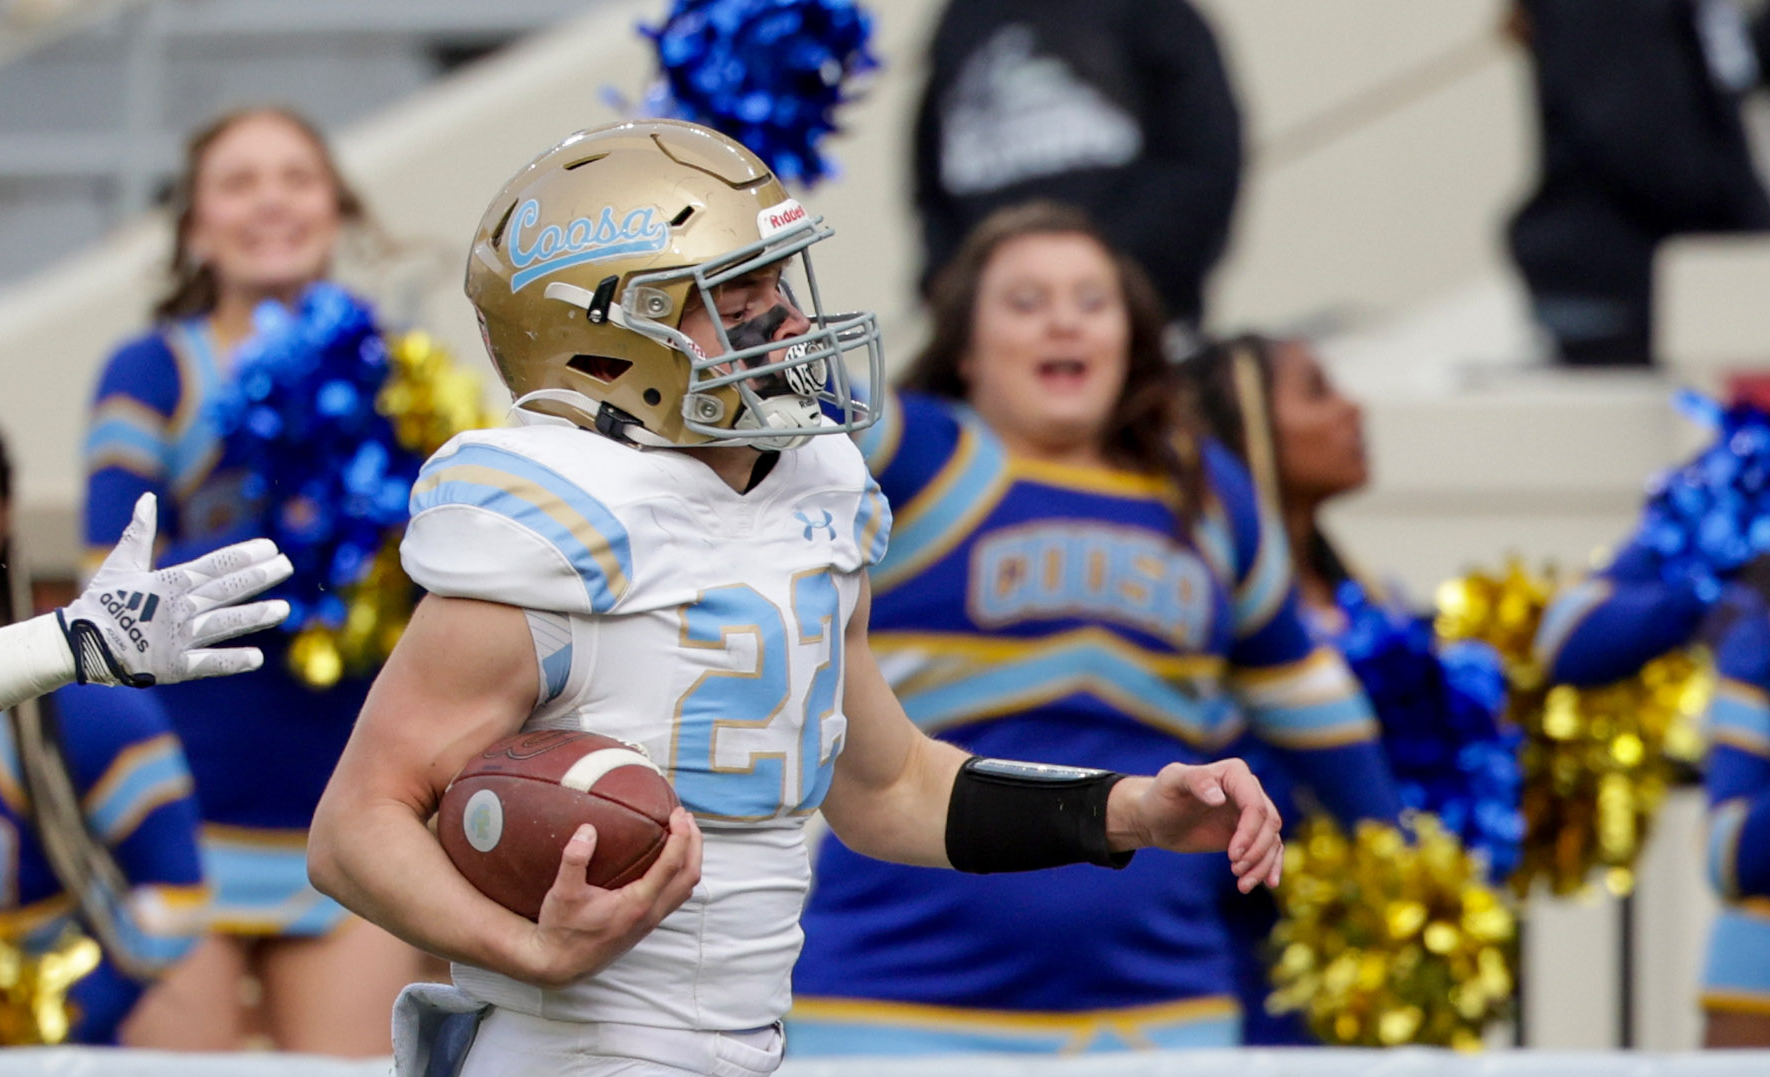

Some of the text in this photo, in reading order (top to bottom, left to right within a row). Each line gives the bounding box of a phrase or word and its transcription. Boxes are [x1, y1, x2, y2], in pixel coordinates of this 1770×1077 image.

[510, 199, 667, 270] Coosa
[99, 592, 149, 653] adidas
[668, 567, 843, 821] 22
